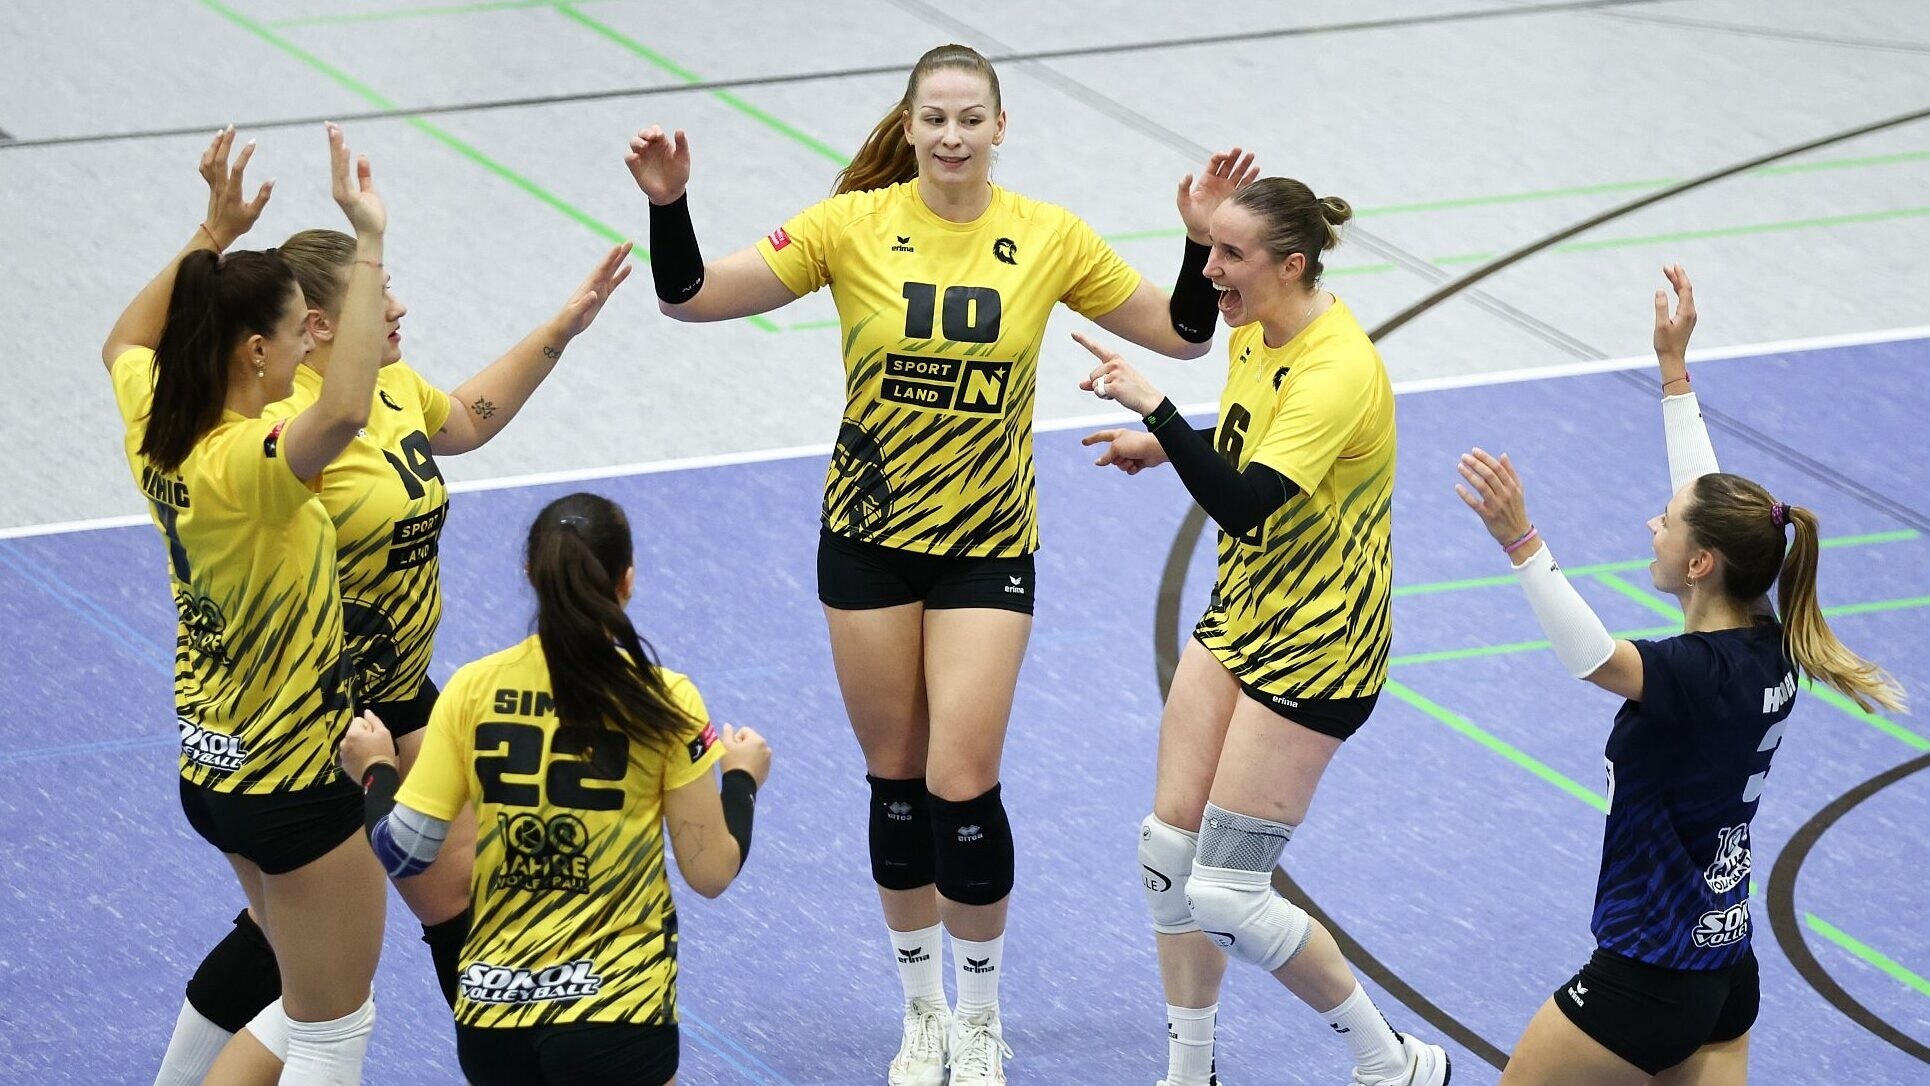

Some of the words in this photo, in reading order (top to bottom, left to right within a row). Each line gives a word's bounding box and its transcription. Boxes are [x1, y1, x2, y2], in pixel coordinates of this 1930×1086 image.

[891, 244, 914, 252] erima
[902, 281, 1002, 343] 10
[893, 359, 952, 376] SPORT
[894, 384, 939, 403] LAND
[963, 368, 1001, 405] N
[1218, 402, 1251, 470] 6
[402, 514, 439, 538] SPORT
[1005, 586, 1025, 595] erima
[1272, 695, 1299, 708] erima
[474, 721, 630, 811] 22
[1695, 924, 1747, 944] VOLLE
[898, 953, 930, 964] erima
[461, 962, 599, 990] SOKOL
[963, 964, 995, 974] erima
[461, 983, 597, 1001] VOLLEYBALL
